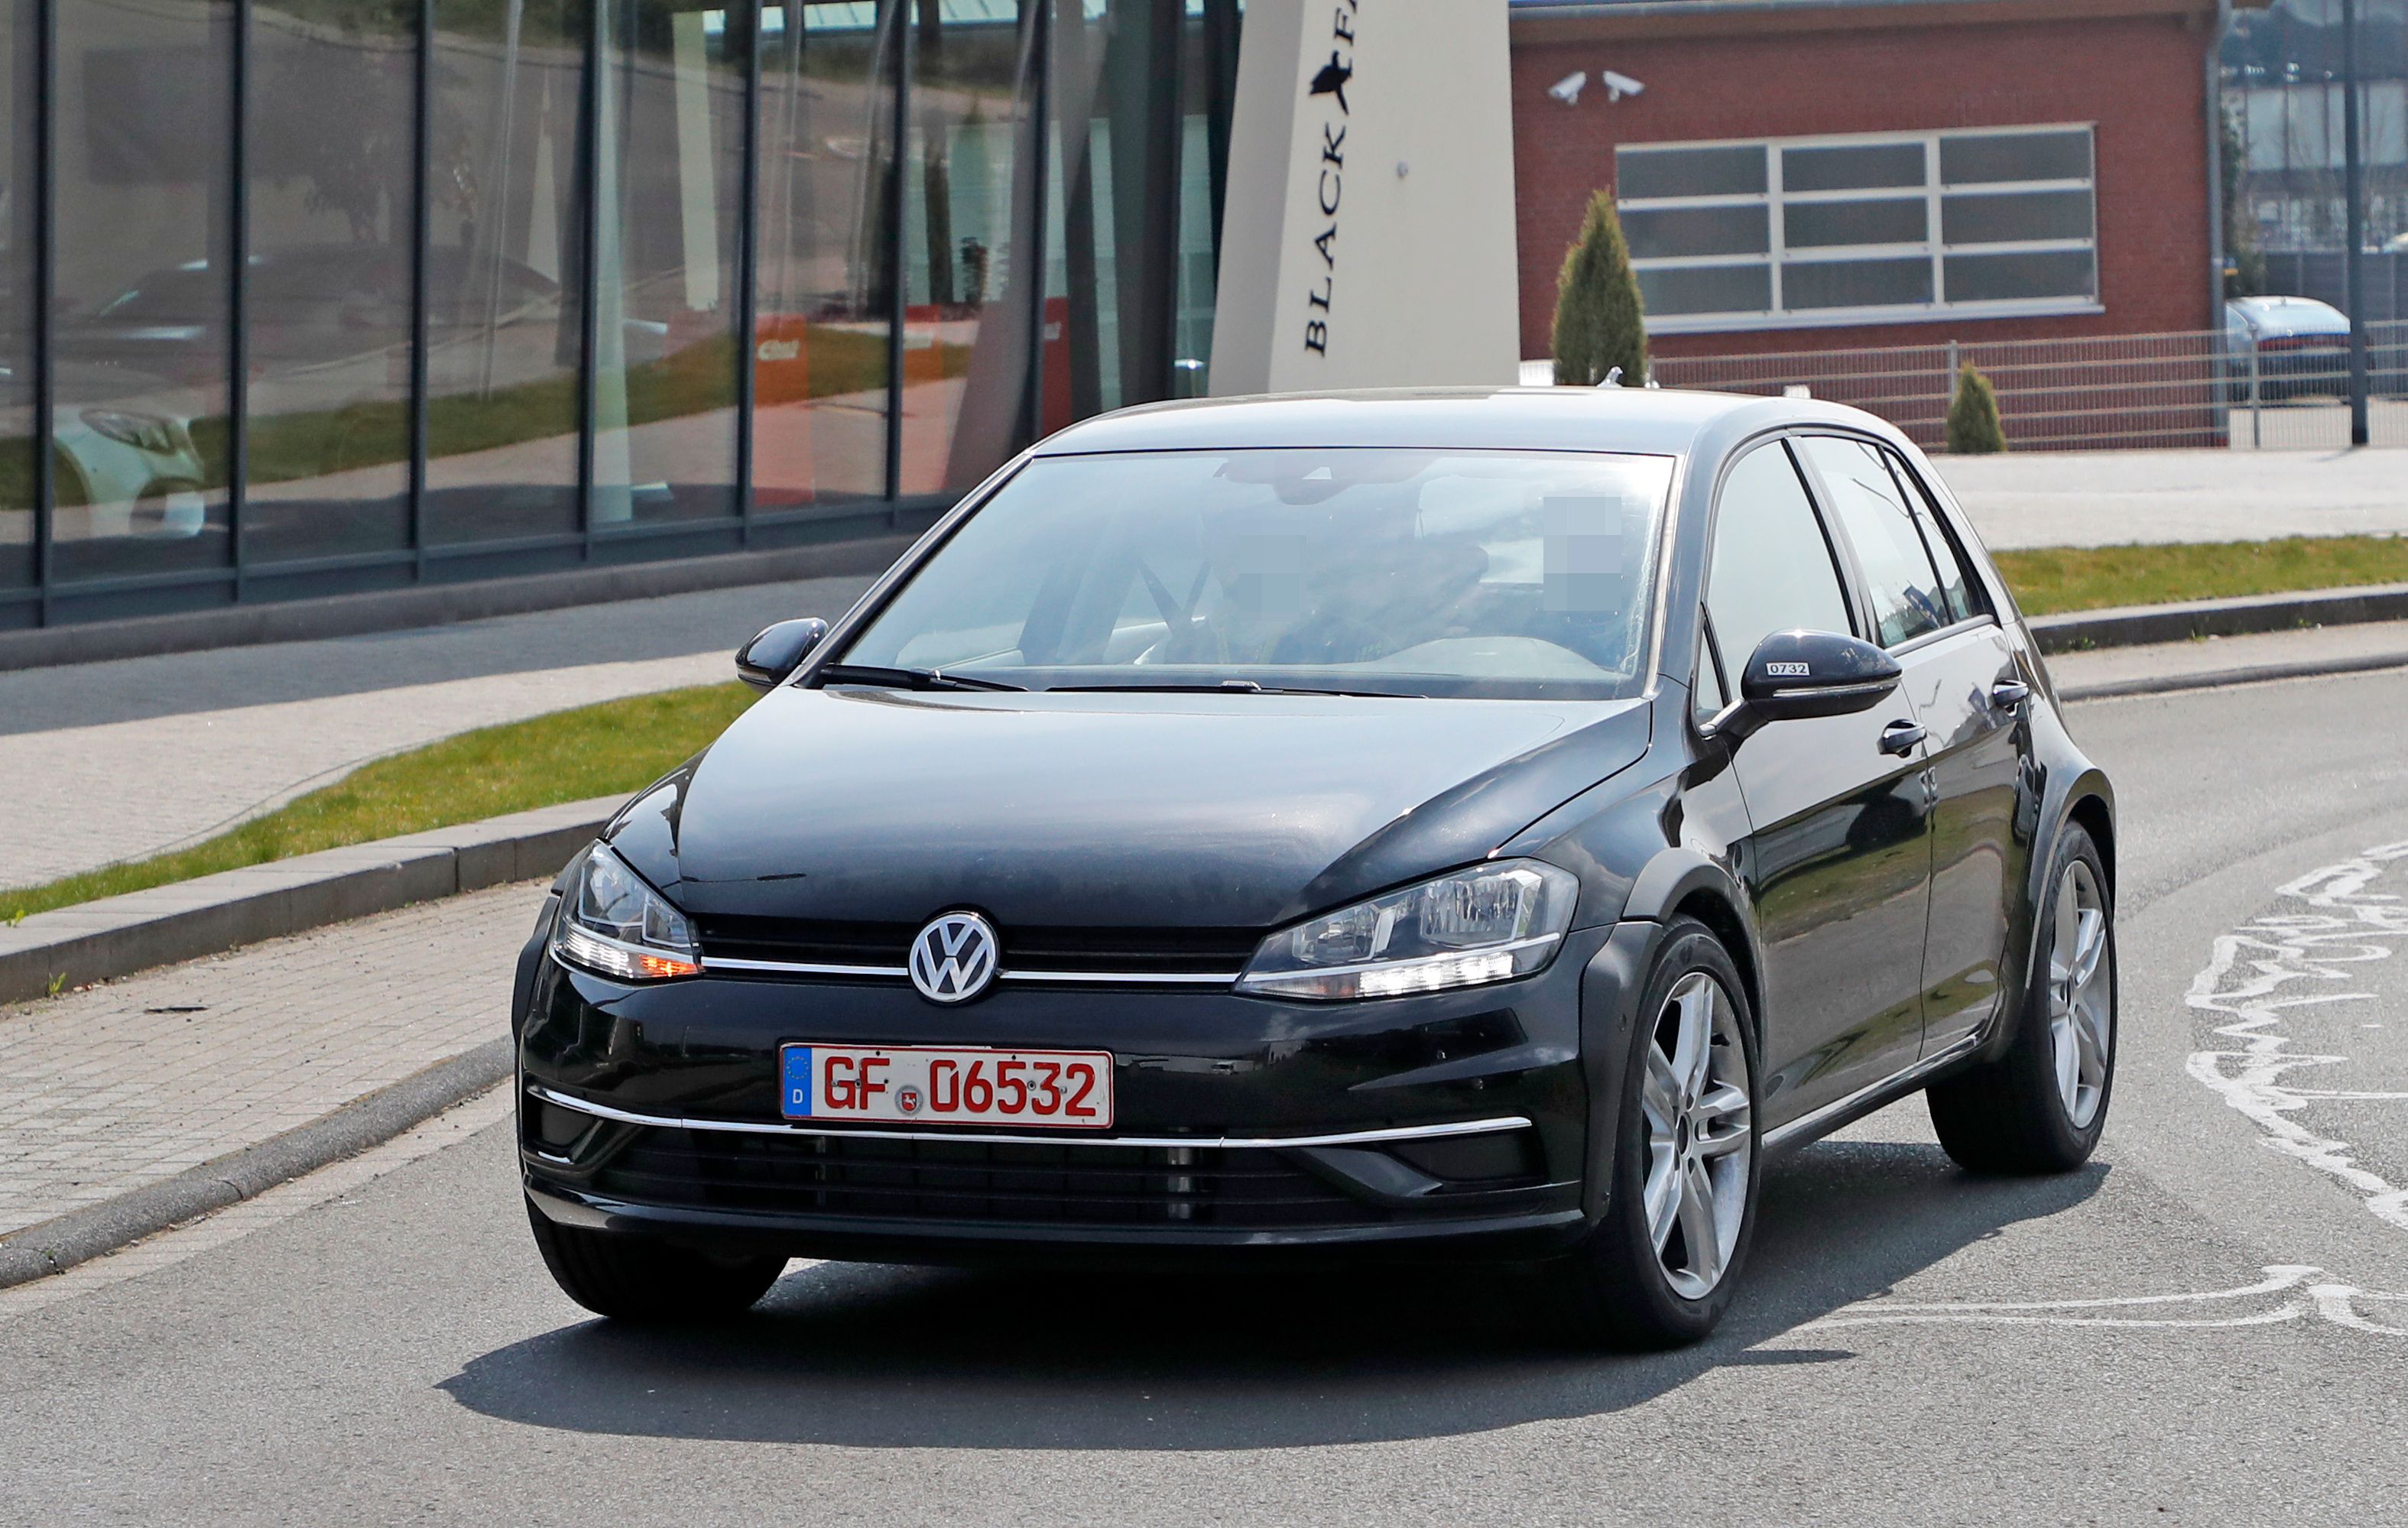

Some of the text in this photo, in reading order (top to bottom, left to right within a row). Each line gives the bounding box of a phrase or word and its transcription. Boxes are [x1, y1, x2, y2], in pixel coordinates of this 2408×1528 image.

[1305, 122, 1346, 358] BLACK
[1770, 664, 1807, 673] 0732
[914, 916, 991, 997] VW
[792, 1088, 803, 1104] D
[824, 1056, 1096, 1117] GF 06532
